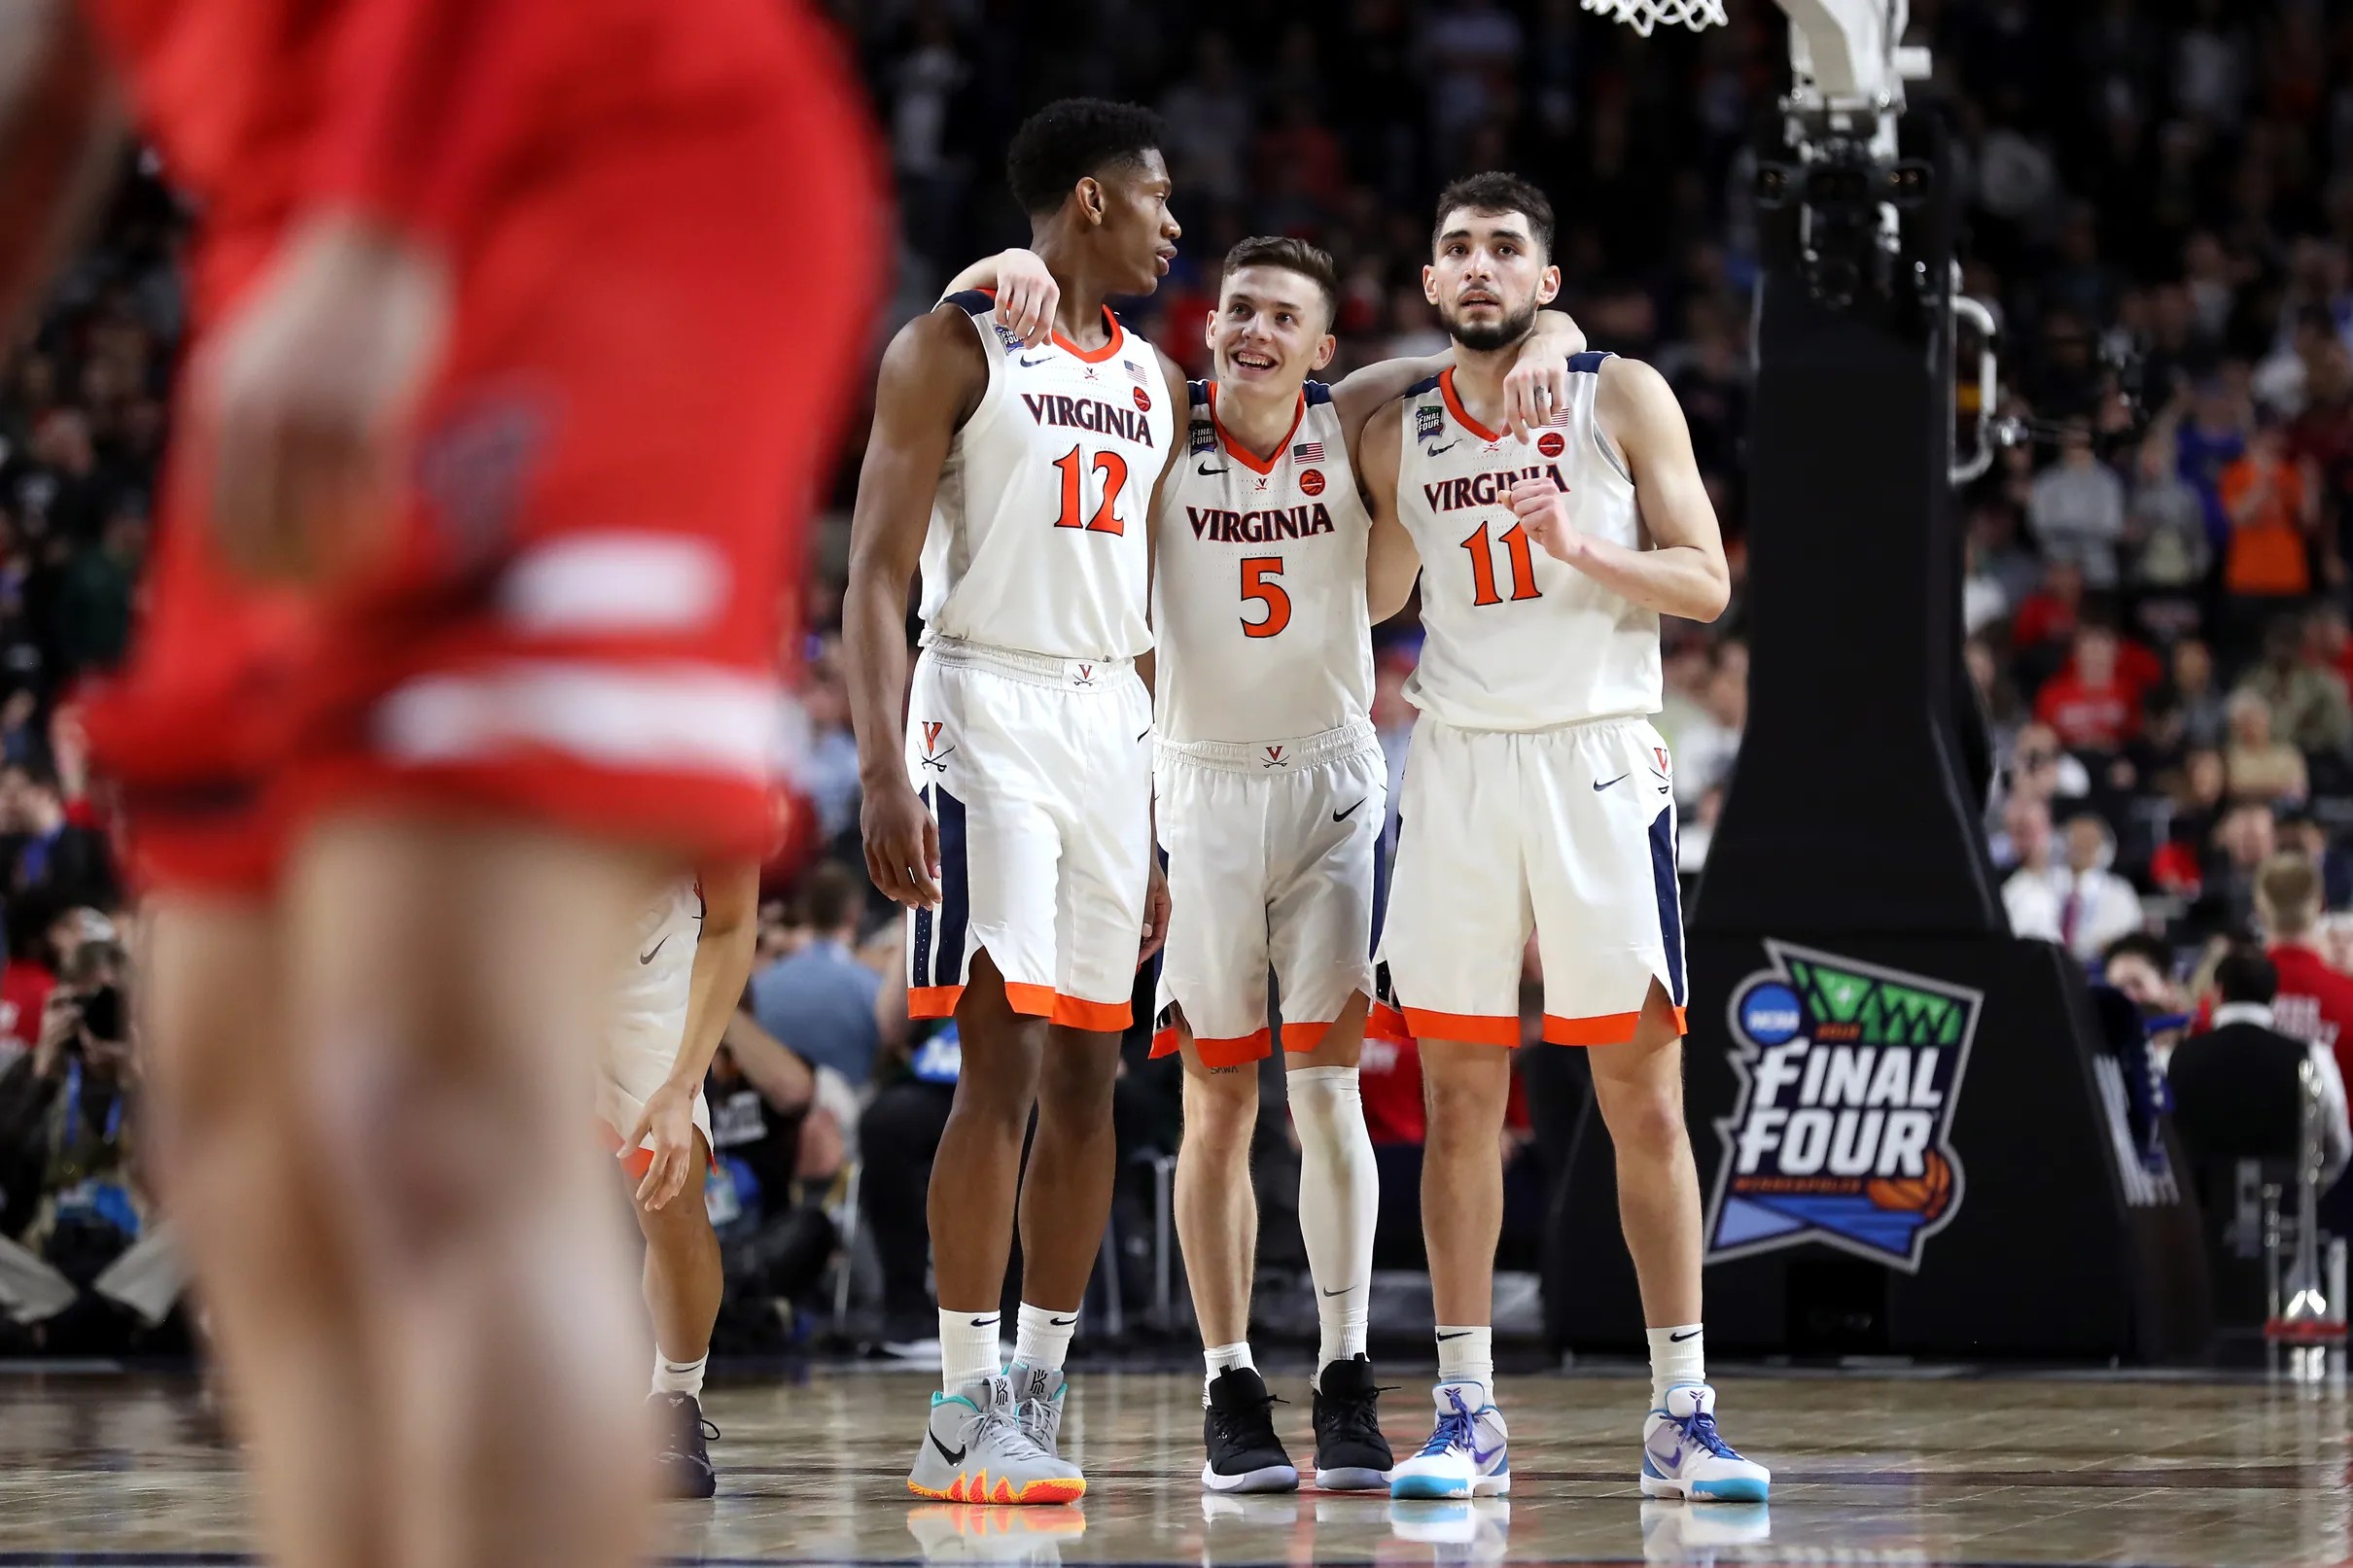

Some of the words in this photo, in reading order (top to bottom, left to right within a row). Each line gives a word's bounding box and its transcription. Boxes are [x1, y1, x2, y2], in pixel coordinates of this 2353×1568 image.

[1021, 393, 1154, 448] VIRGINIA
[1192, 428, 1214, 437] FINAL
[1192, 436, 1214, 445] FOUR
[1419, 419, 1440, 433] FOUR
[1420, 412, 1440, 425] FINAL
[1052, 443, 1128, 537] 12
[1185, 503, 1335, 542] VIRGINIA
[1460, 520, 1542, 606] 11
[1240, 556, 1291, 638] 5
[1755, 1036, 1944, 1109] FINAL
[1737, 1107, 1934, 1177] FOUR
